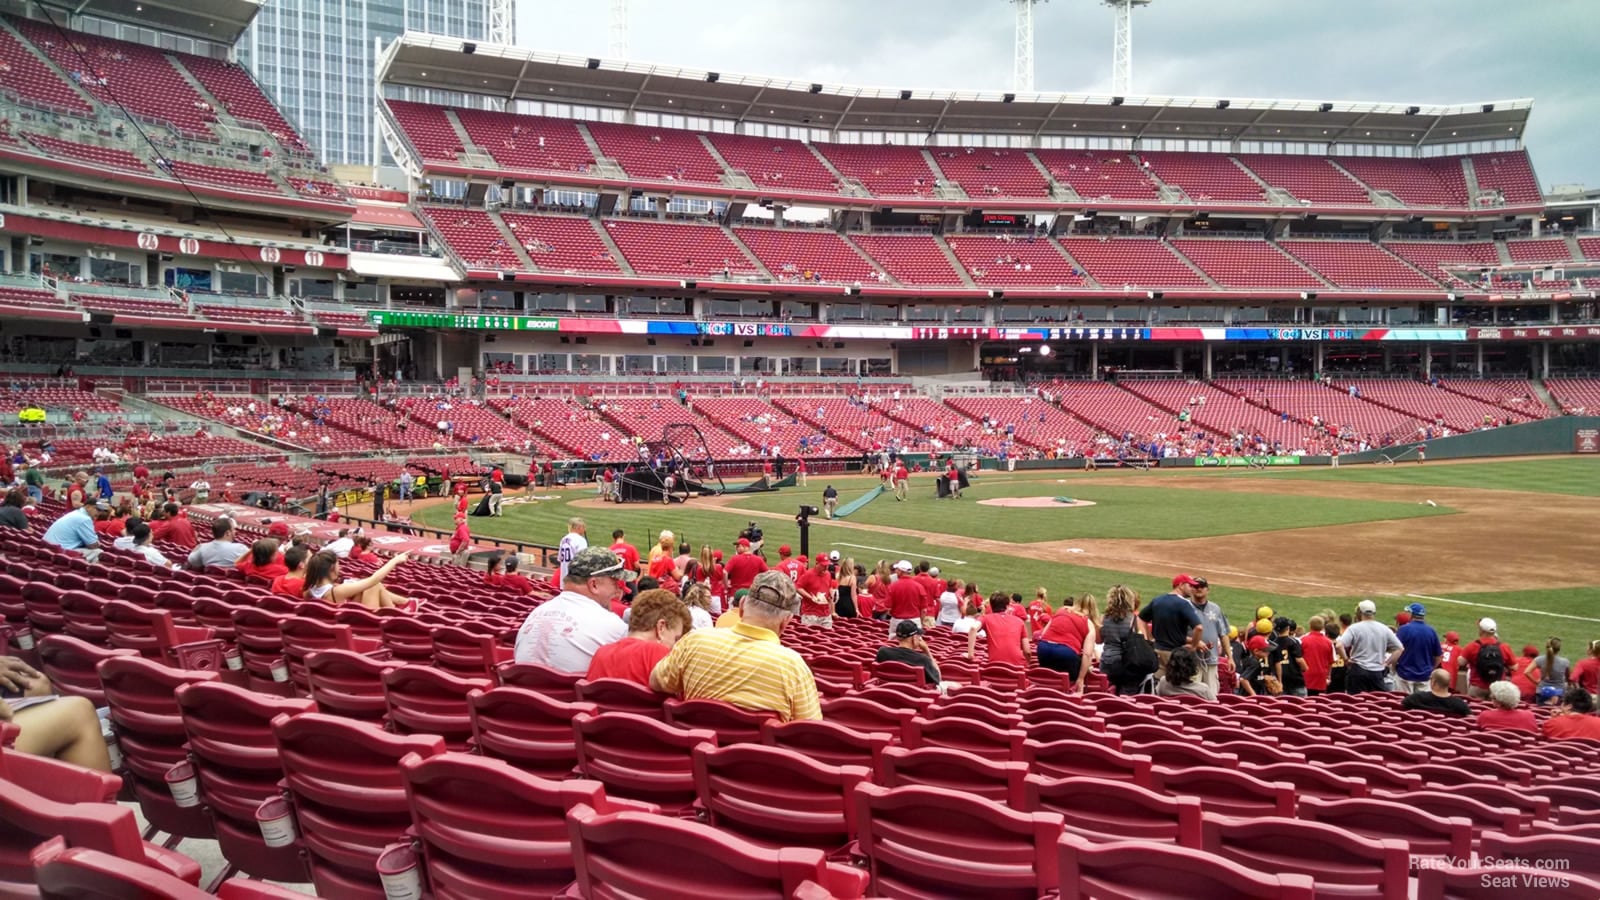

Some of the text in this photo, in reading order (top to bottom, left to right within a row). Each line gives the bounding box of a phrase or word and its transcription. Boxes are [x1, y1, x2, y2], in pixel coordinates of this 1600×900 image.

[141, 234, 156, 249] 24
[183, 238, 196, 254] 10
[263, 248, 276, 262] 13
[308, 252, 320, 265] 11
[738, 325, 754, 334] VS
[1304, 330, 1319, 339] VS
